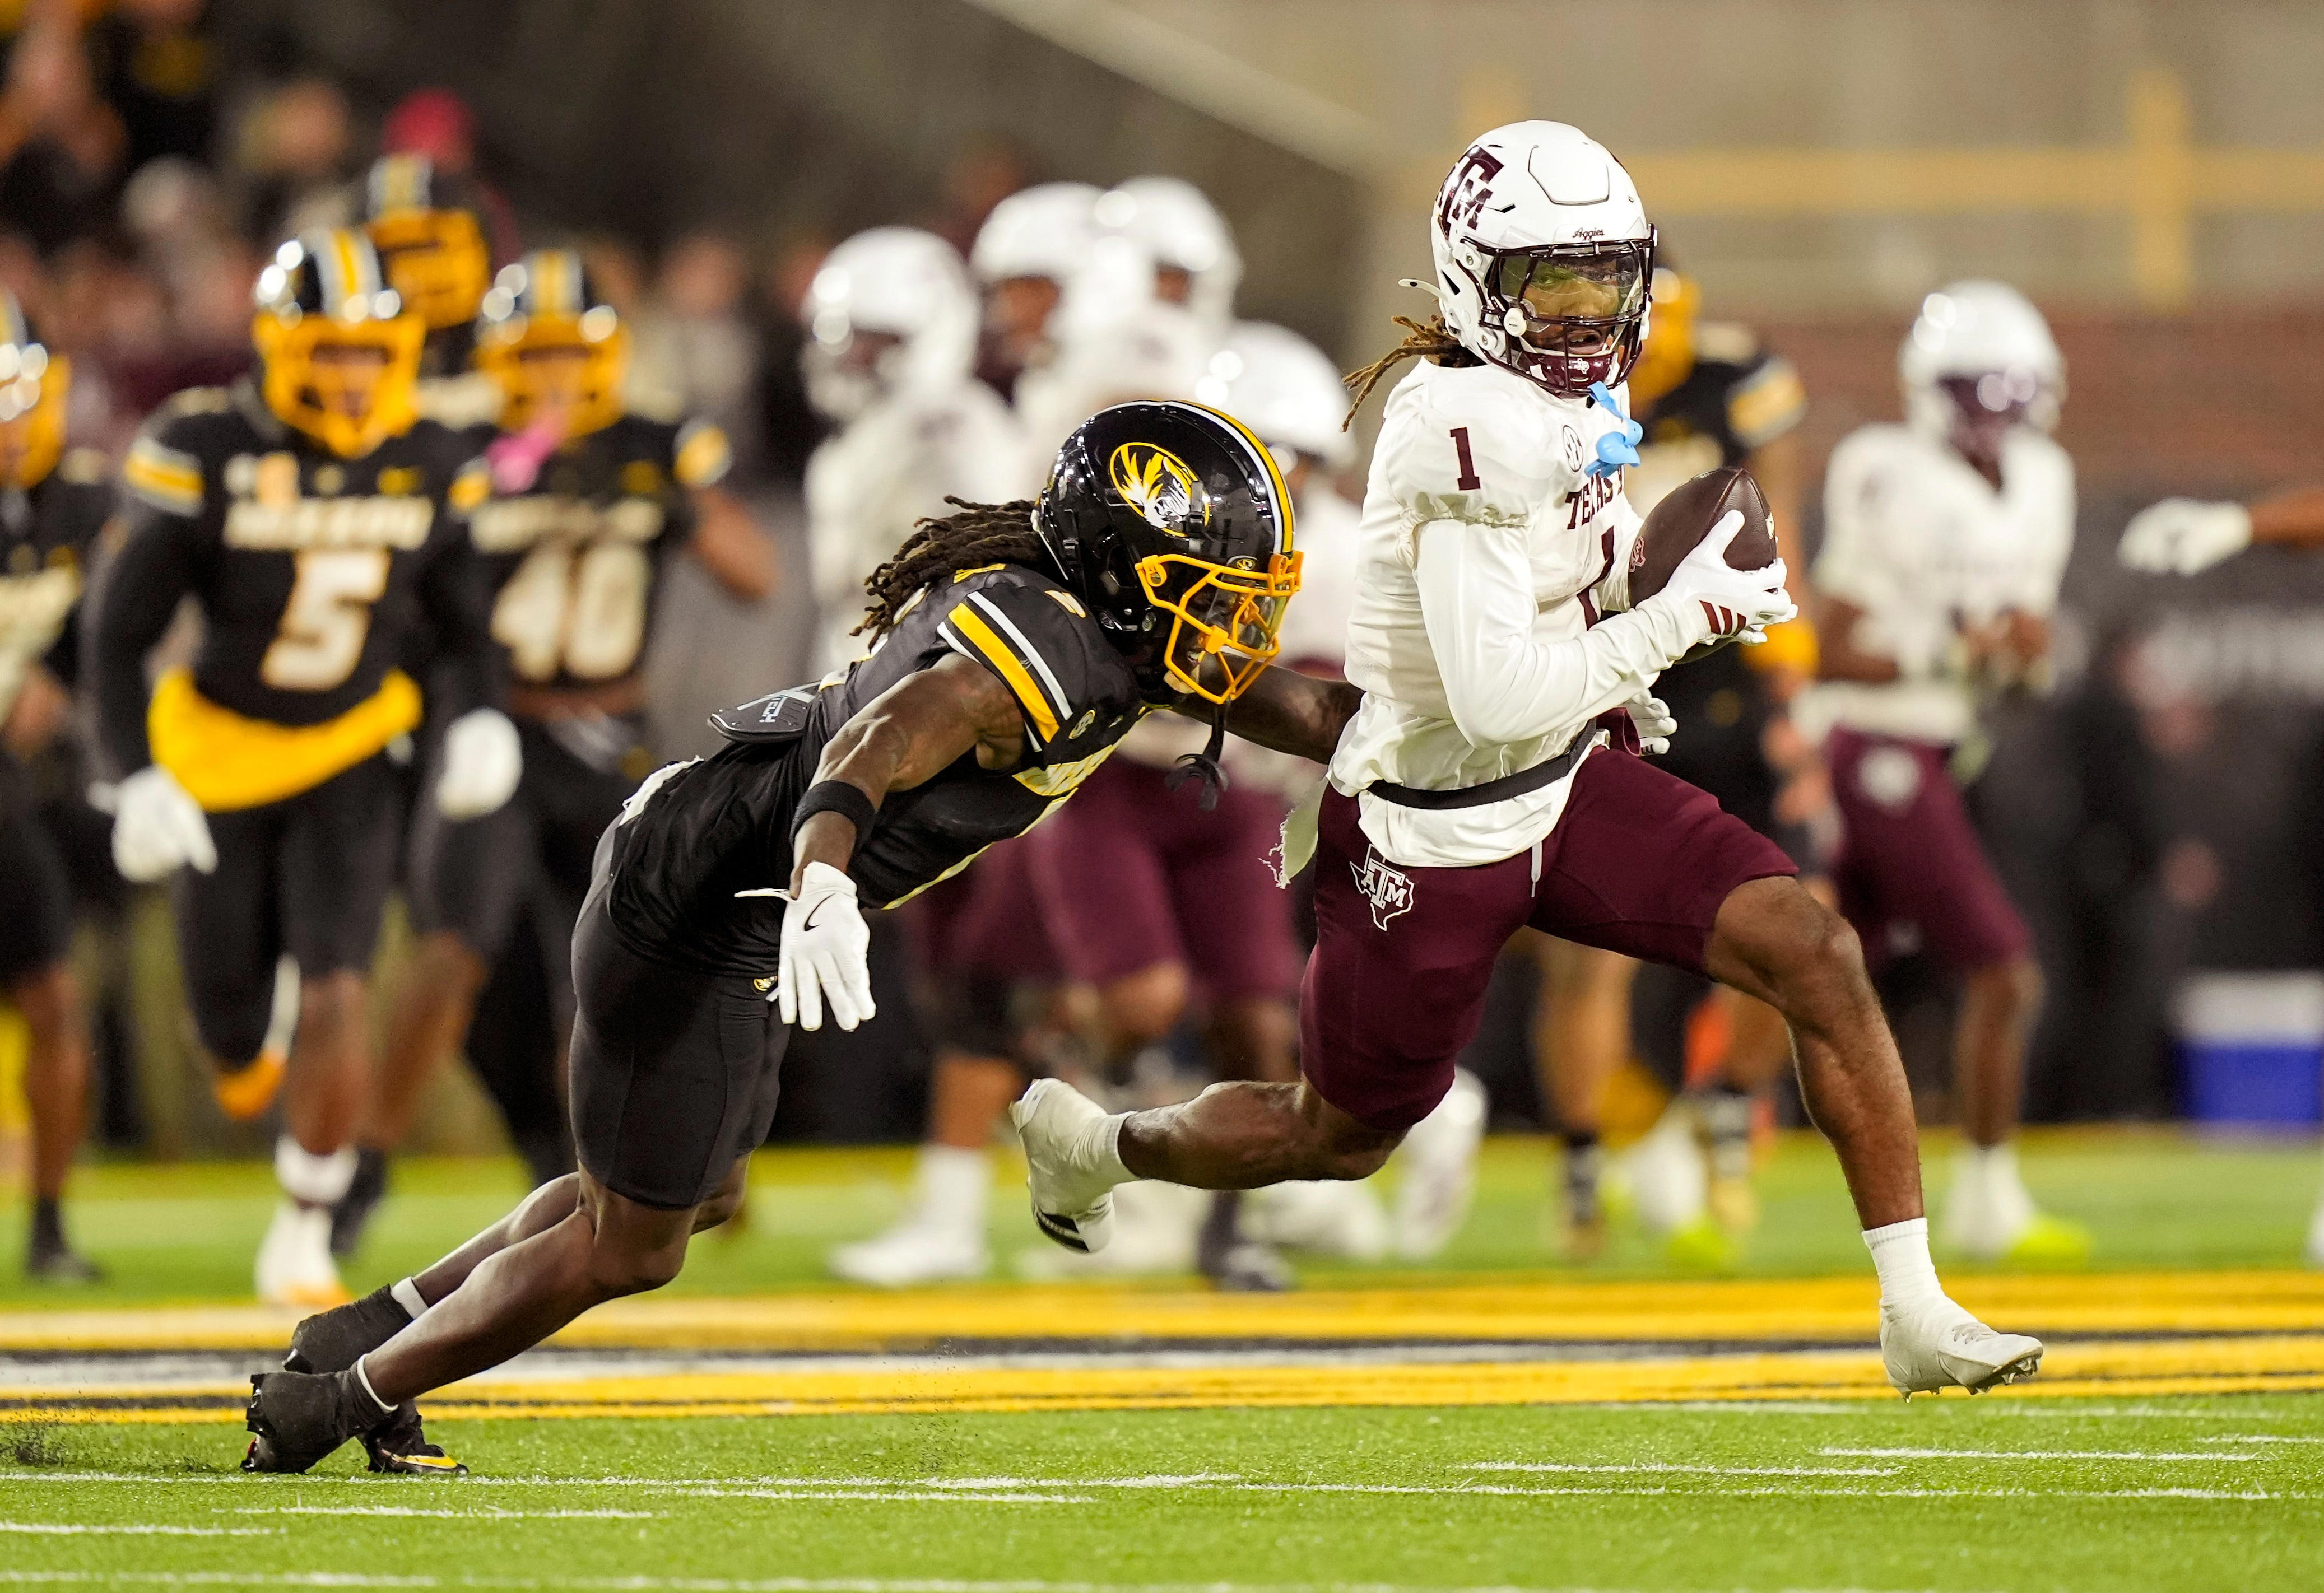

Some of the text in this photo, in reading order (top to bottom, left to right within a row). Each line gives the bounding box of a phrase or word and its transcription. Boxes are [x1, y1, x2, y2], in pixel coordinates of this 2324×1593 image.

[1572, 227, 1605, 241] Aggies
[1450, 427, 1481, 491] 1
[261, 548, 391, 691] 5
[490, 541, 654, 680] 40
